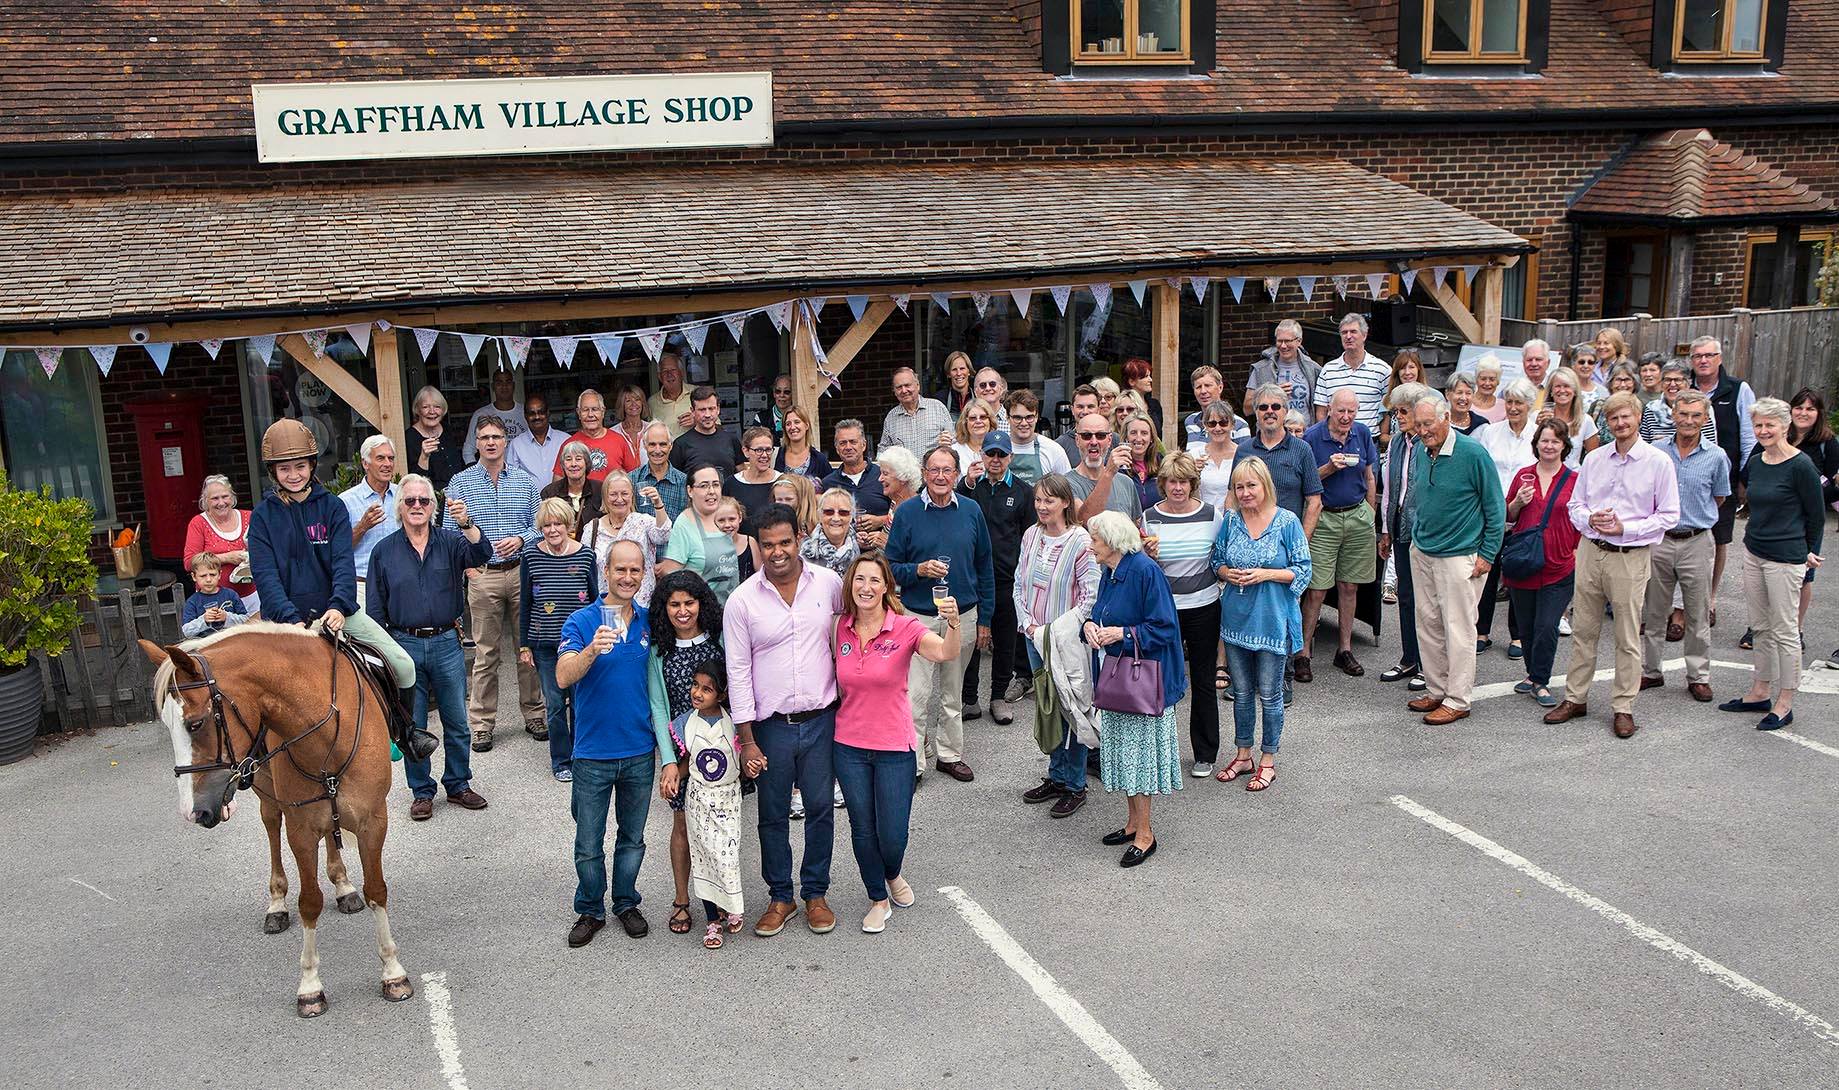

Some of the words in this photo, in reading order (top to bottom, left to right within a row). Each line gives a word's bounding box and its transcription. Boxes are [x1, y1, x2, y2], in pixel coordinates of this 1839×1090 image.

[277, 103, 485, 135] GRAFFHAM
[498, 98, 650, 129] VILLAGE
[663, 95, 753, 123] SHOP
[302, 388, 326, 398] NOW
